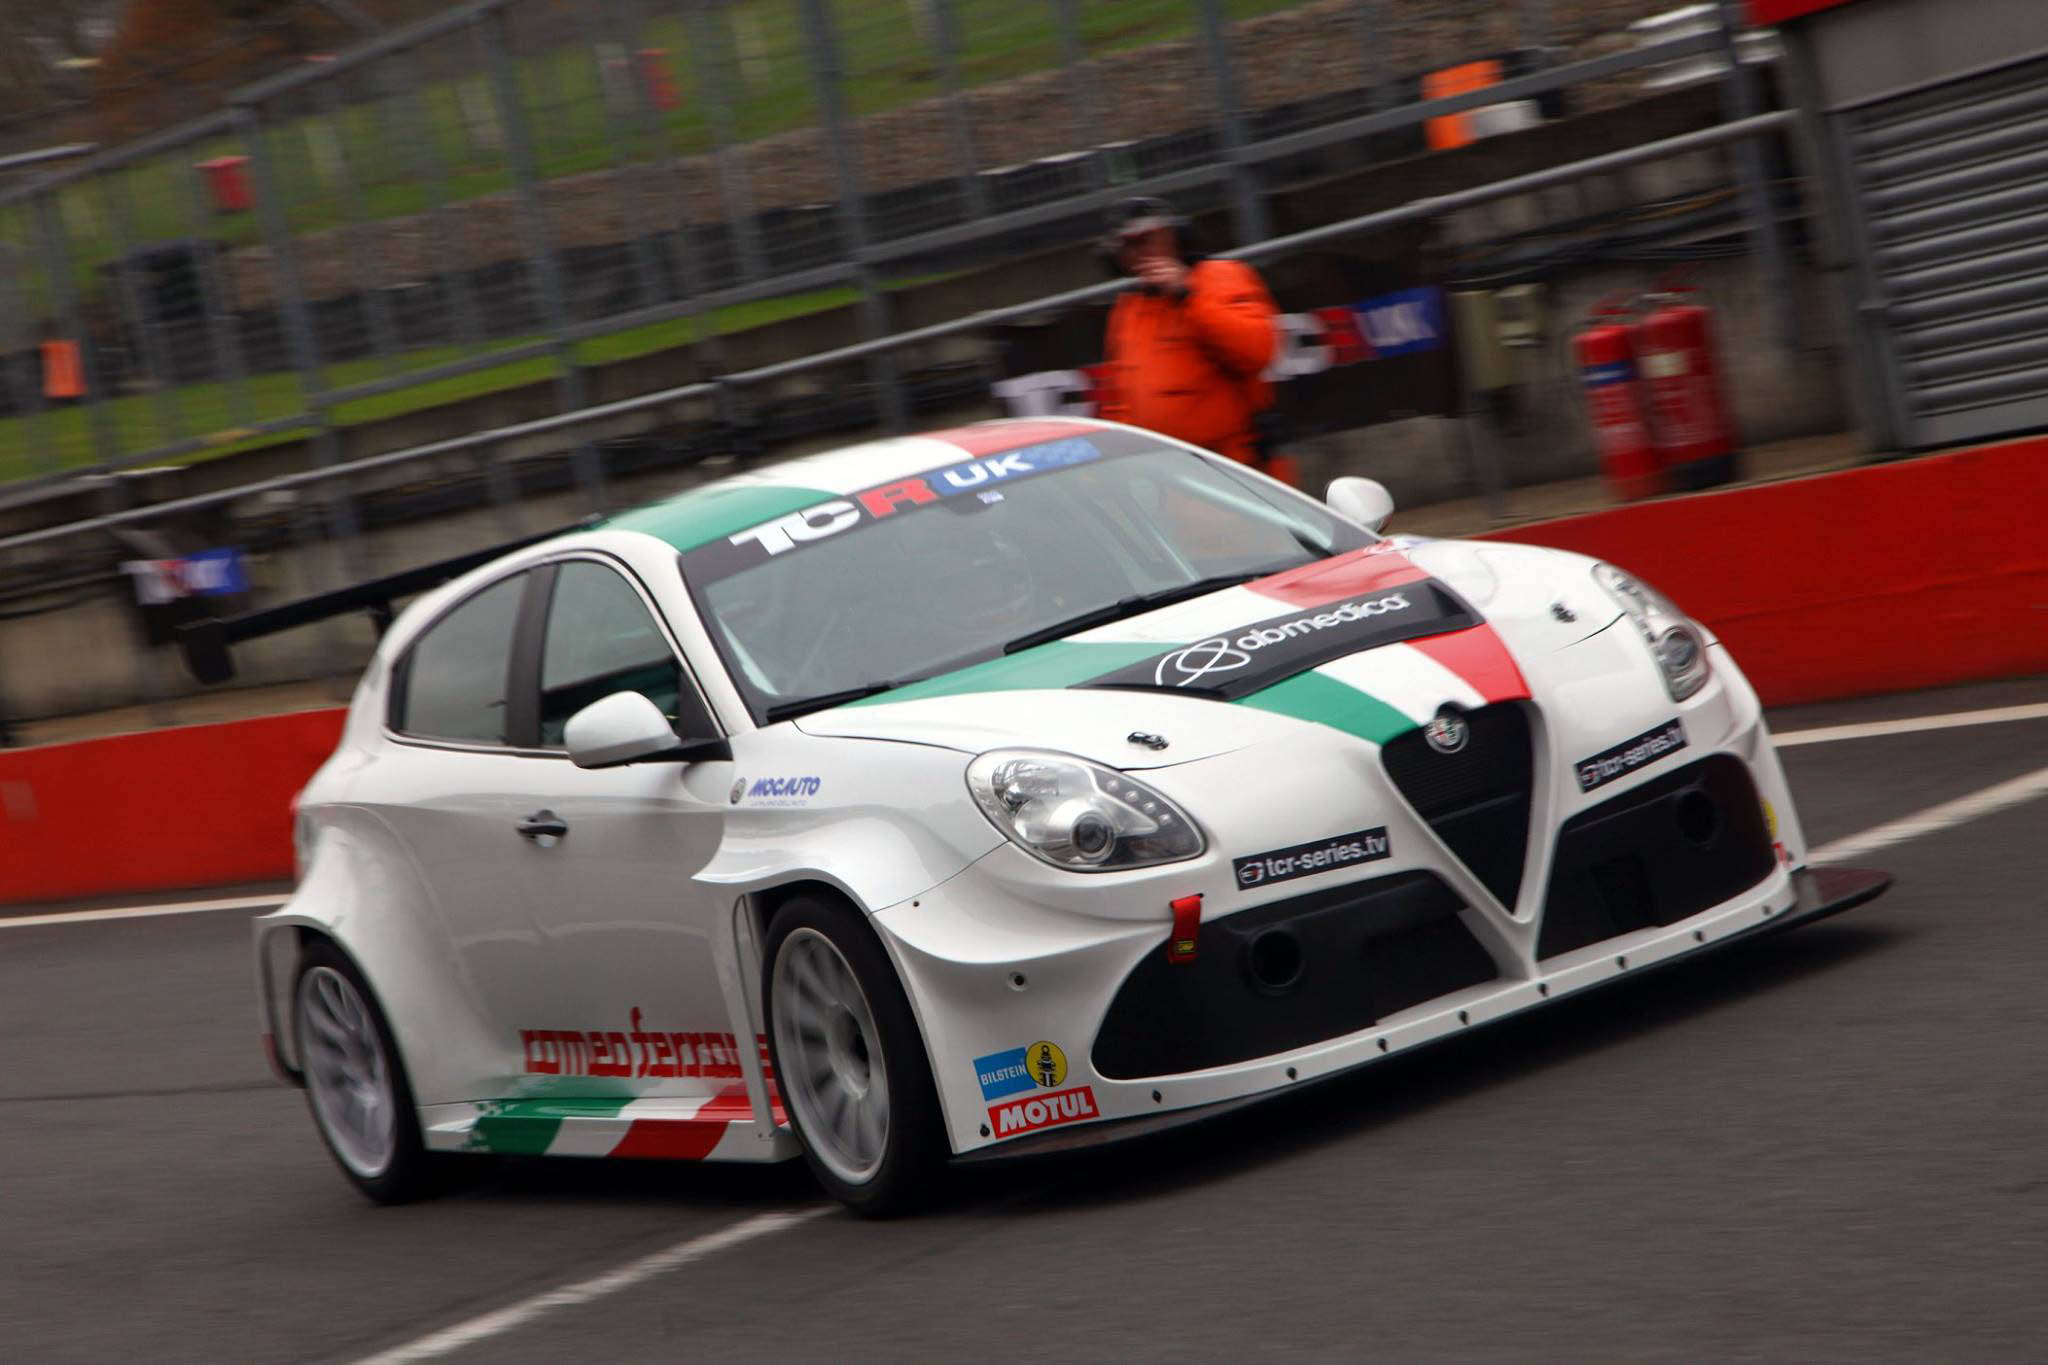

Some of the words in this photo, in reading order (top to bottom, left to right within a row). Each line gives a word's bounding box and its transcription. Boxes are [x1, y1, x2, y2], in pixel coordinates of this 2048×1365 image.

[728, 477, 939, 556] TCR
[942, 452, 1035, 488] UK
[747, 776, 821, 797] MOCAUTO
[1266, 834, 1387, 878] tcr-series.tv
[519, 1006, 776, 1080] romeoferras
[980, 1064, 1027, 1087] BILSTEIN
[1000, 1091, 1094, 1134] MOTUL
